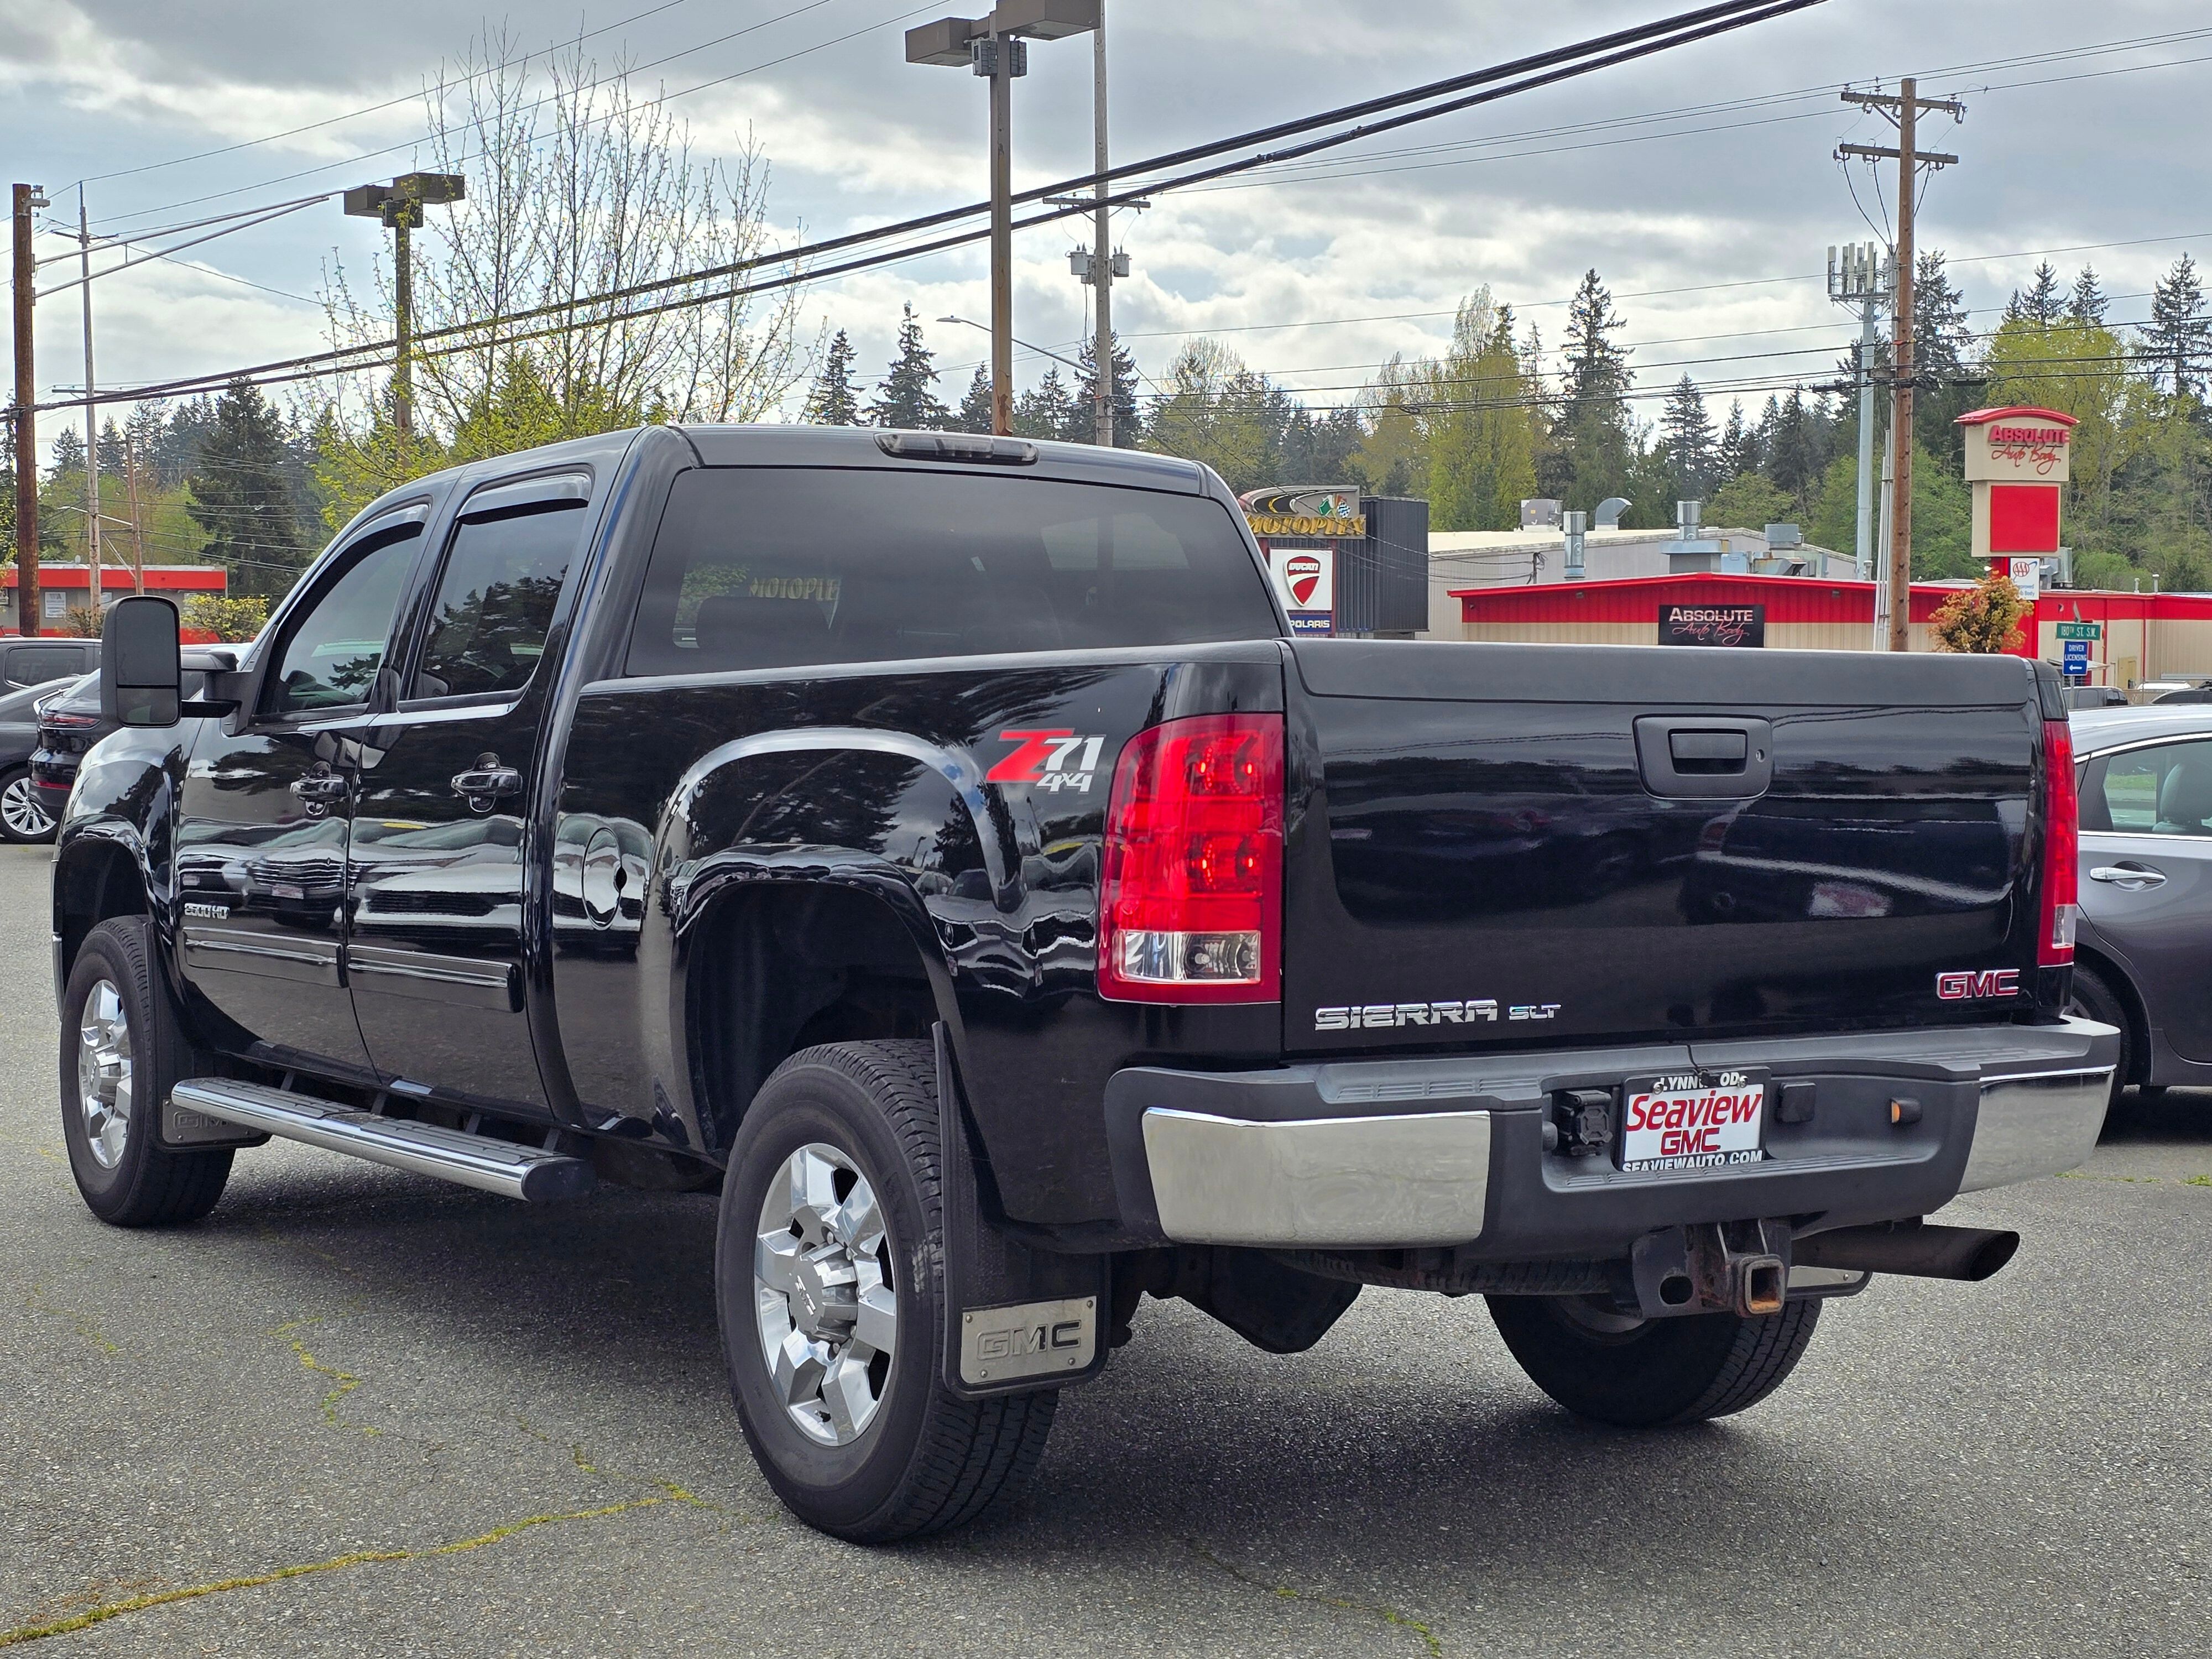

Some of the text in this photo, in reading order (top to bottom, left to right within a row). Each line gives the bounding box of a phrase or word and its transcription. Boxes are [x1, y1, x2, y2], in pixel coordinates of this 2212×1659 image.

[1988, 425, 2069, 444] ABSOLUTE
[1991, 442, 2061, 475] Auto Body
[1246, 515, 1366, 535] MOTOPLEX
[1288, 562, 1319, 571] DUCATI
[2014, 562, 2028, 576] AAA
[1290, 619, 1330, 628] POLARIS
[1669, 607, 1754, 622] ABSOLUTE
[1672, 618, 1750, 646] Auto Body
[986, 728, 1105, 782] Z71
[1936, 969, 2020, 999] GMC
[1314, 999, 1562, 1031] SIERRA SLT
[1659, 1072, 1740, 1092] LYNNOD
[174, 1111, 228, 1129] GM
[1626, 1090, 1762, 1132] Seaview
[1661, 1127, 1720, 1156] GMC
[1623, 1150, 1763, 1172] SEAVIEWAUTO.COM
[977, 1319, 1082, 1361] GMC
